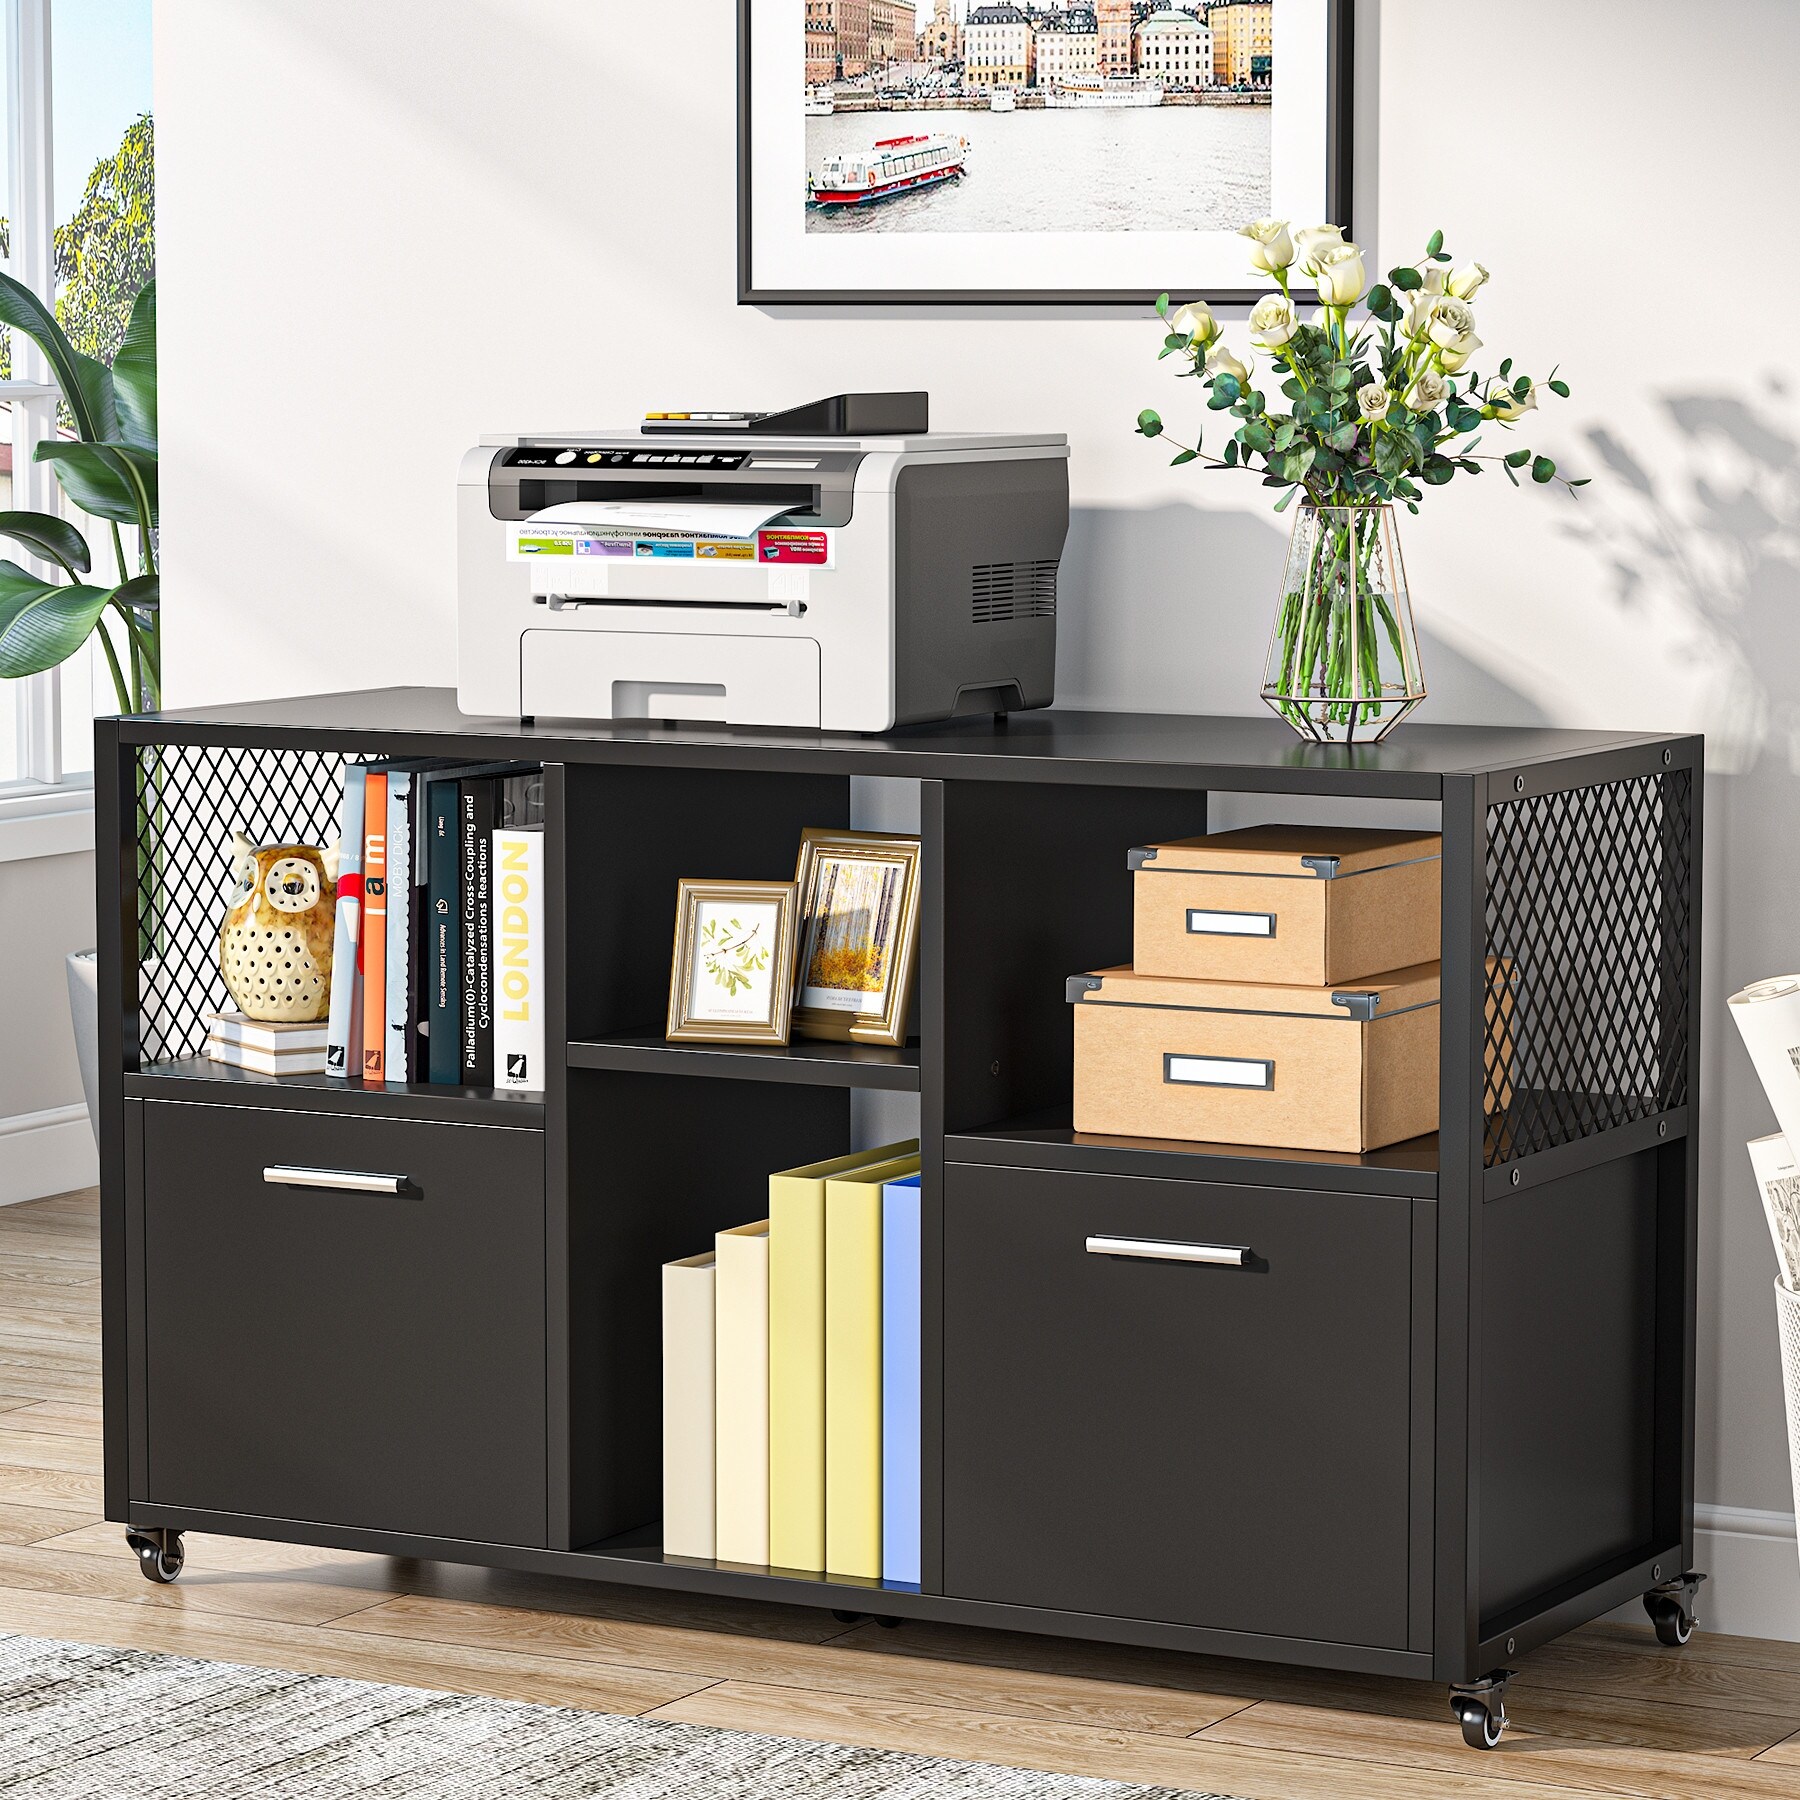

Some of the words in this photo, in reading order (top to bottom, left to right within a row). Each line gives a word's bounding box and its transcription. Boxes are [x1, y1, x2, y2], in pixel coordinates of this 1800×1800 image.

[393, 824, 404, 855] DICK
[464, 795, 474, 820] and
[392, 859, 403, 898] MOBY
[464, 823, 477, 920] Cross-Coupling
[477, 838, 487, 899] Reactions
[477, 902, 490, 1029] Cyclocondensations
[502, 842, 529, 1021] LONDON
[465, 922, 477, 1068] Palladium(0)-Catalyzed
